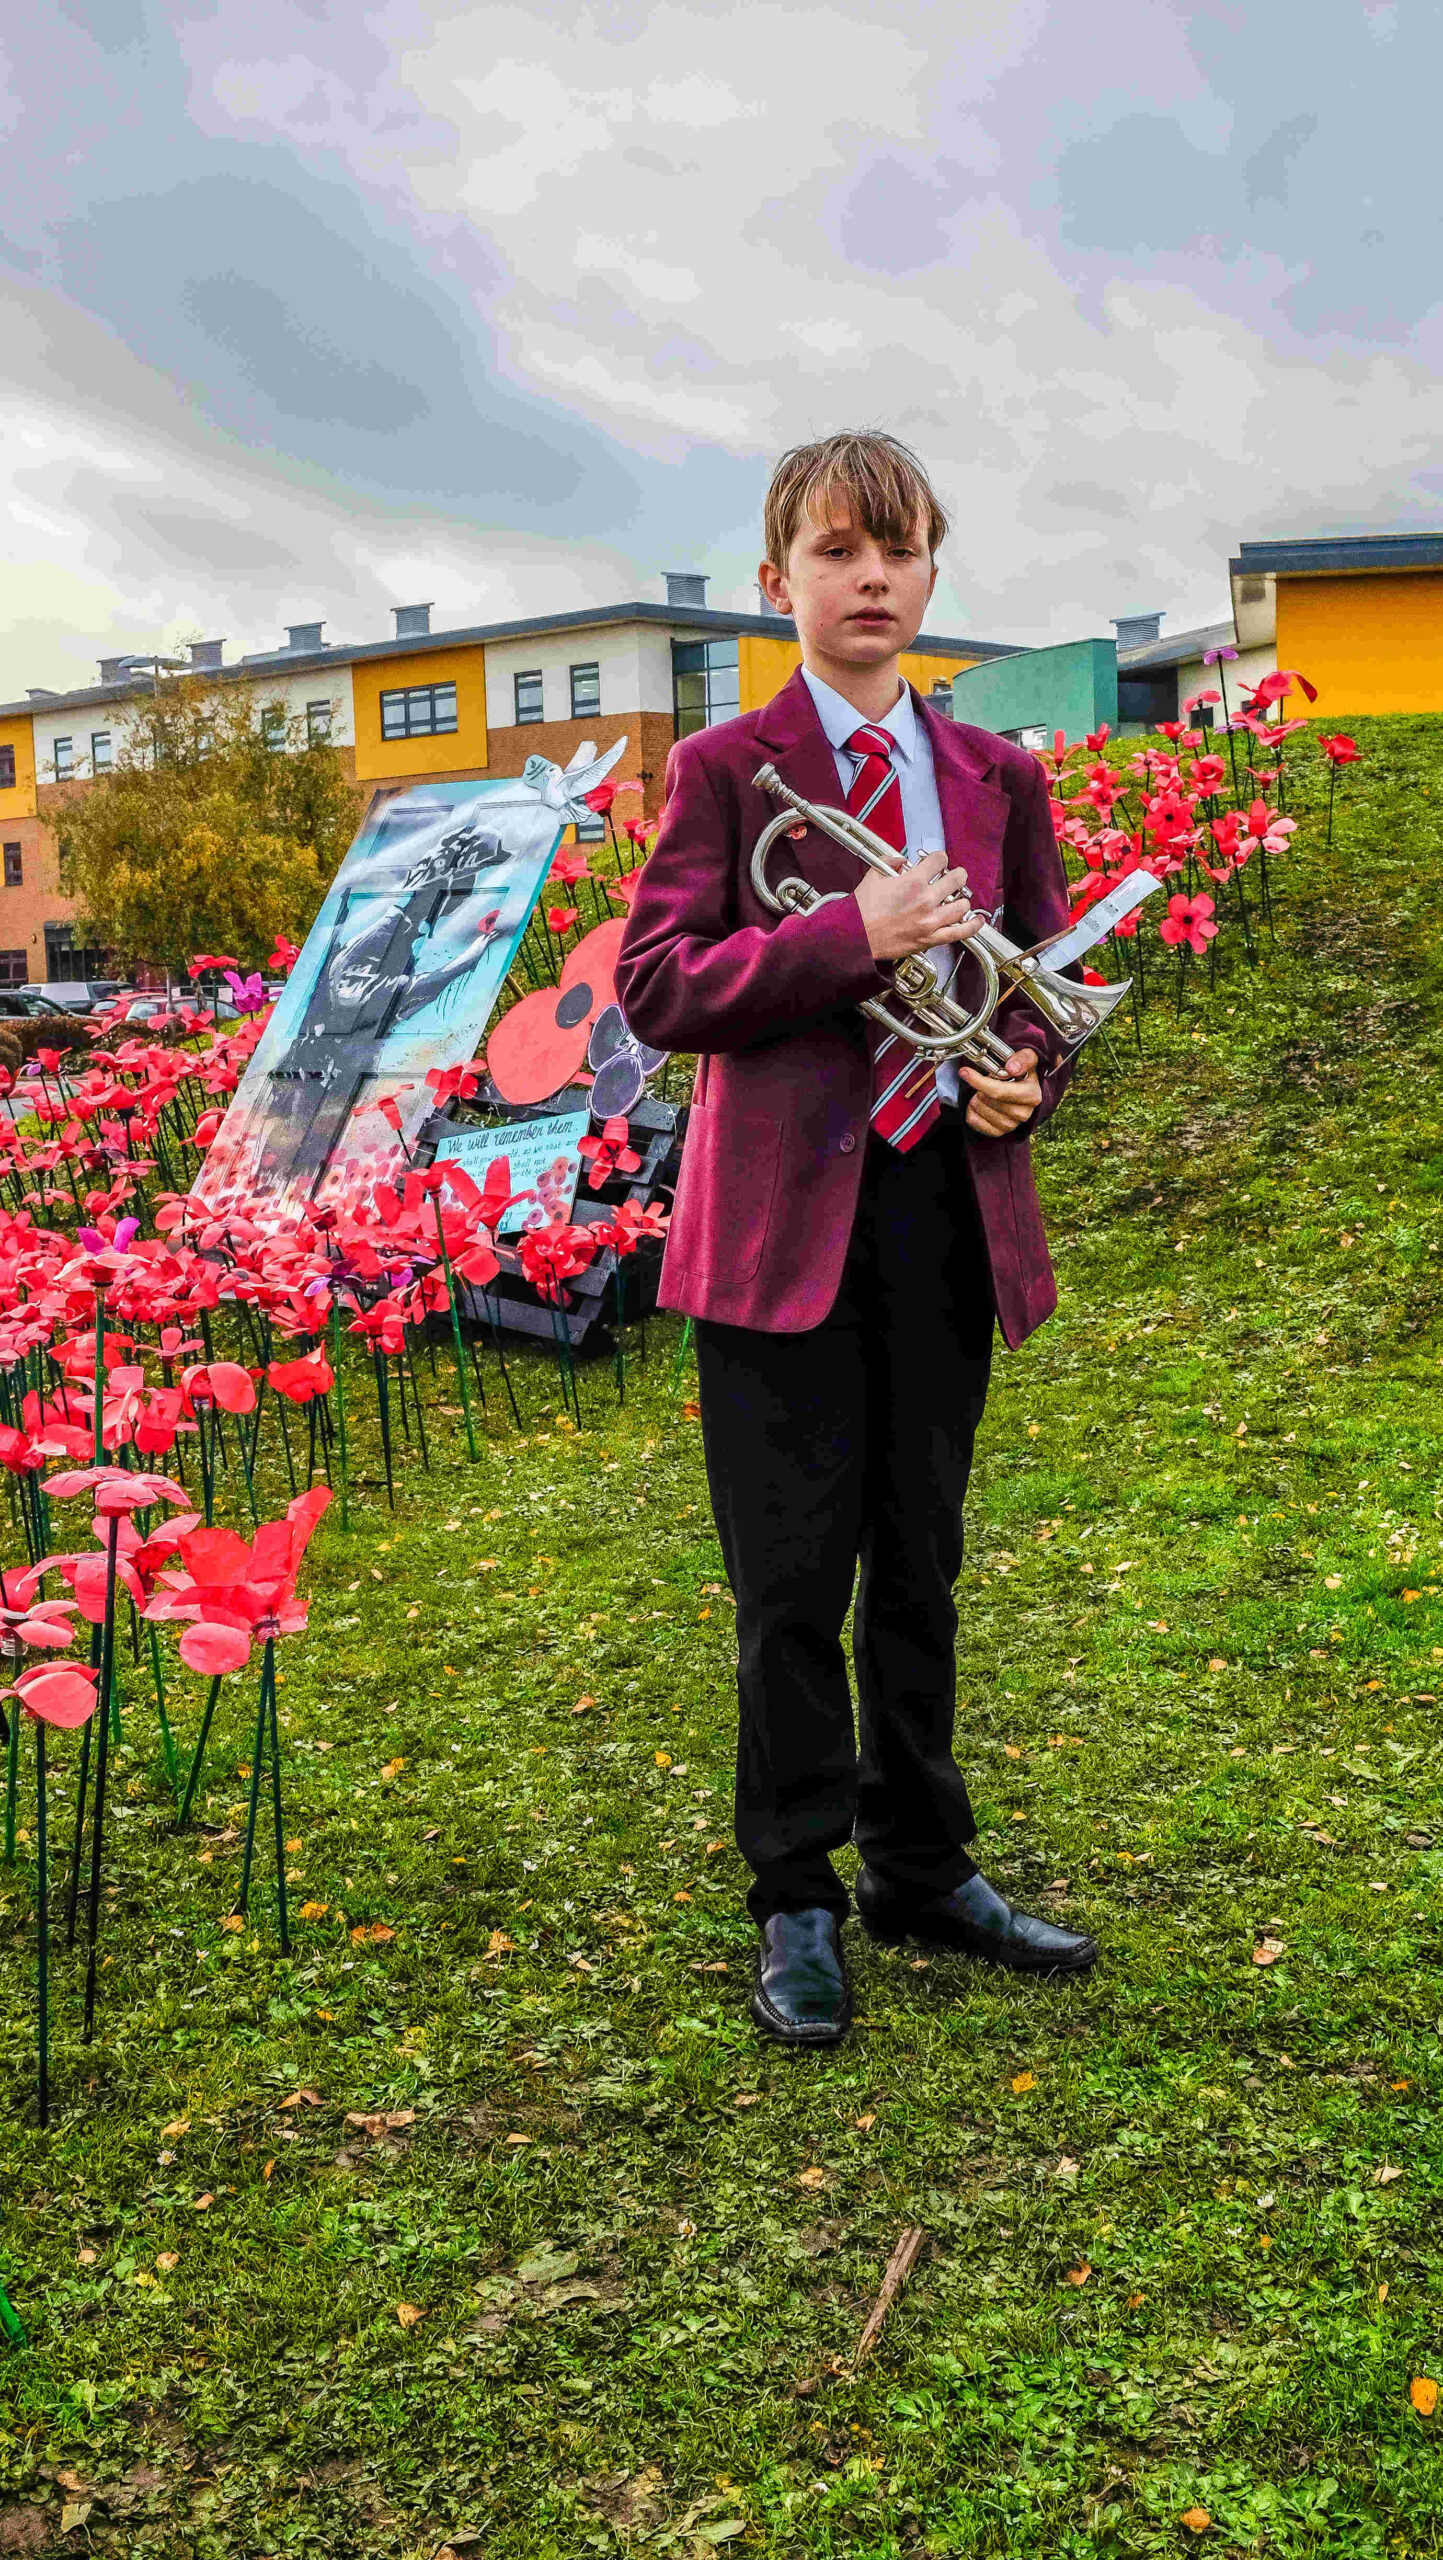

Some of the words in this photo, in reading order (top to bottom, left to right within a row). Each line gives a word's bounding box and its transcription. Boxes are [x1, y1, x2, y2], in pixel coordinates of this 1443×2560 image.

[448, 1137, 463, 1154] We
[468, 1132, 490, 1151] will
[494, 1123, 543, 1146] remember
